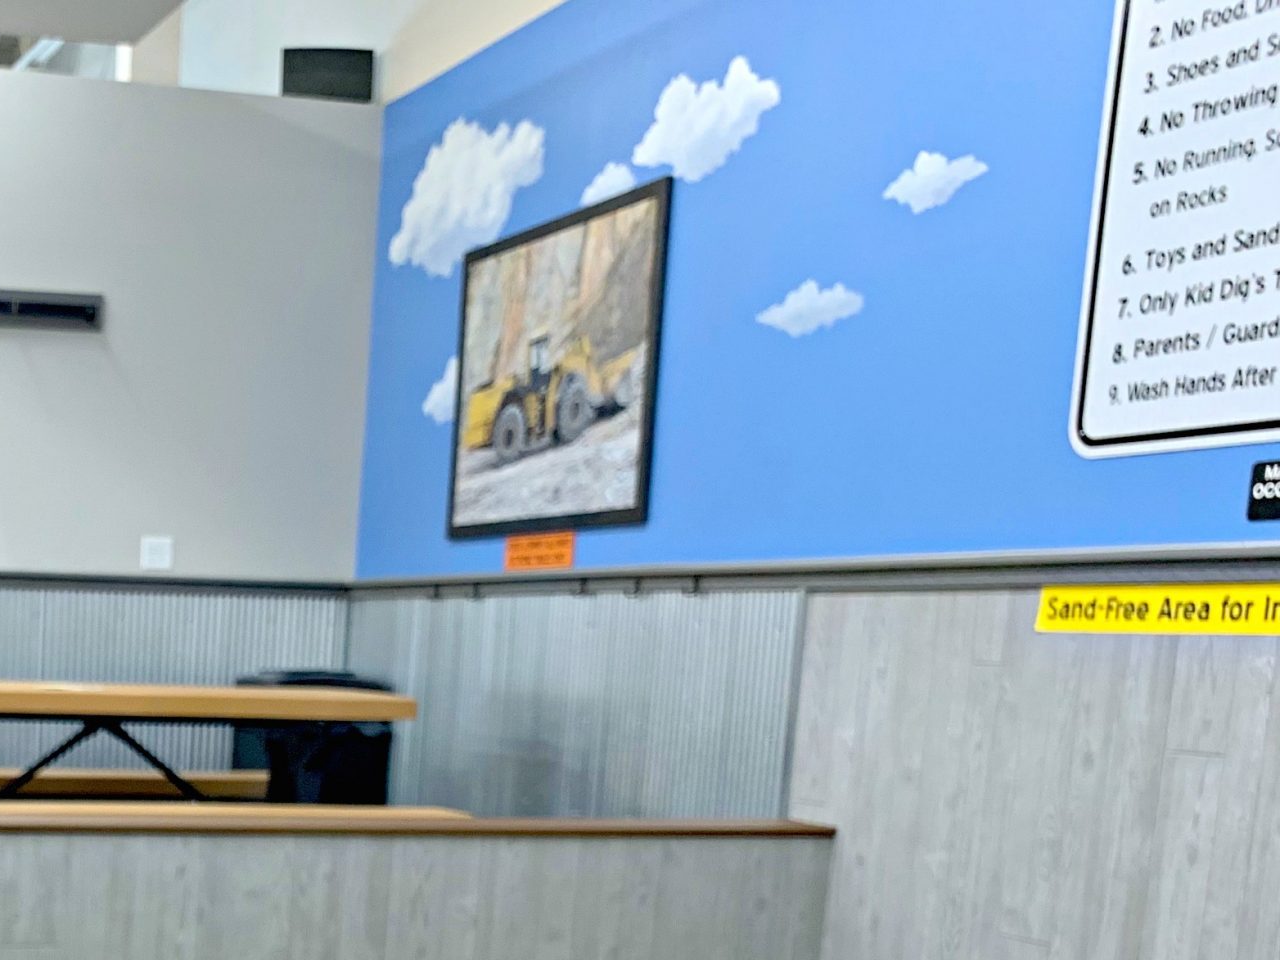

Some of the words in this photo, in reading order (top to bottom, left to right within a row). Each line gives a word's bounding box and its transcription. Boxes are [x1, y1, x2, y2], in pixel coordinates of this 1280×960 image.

[1148, 25, 1166, 49] 2.
[1171, 18, 1196, 42] No
[1143, 71, 1159, 94] 3.
[1166, 55, 1220, 88] Shoes
[1225, 37, 1260, 68] and
[1137, 116, 1154, 137] 4.
[1160, 109, 1185, 133] No
[1192, 83, 1279, 123] Throwing
[1131, 161, 1149, 185] 5.
[1153, 156, 1178, 179] No
[1149, 198, 1171, 219] on
[1176, 184, 1229, 213] Rocks
[1121, 254, 1137, 276] 6.
[1145, 245, 1186, 272] Toys
[1191, 233, 1228, 262] and
[1232, 221, 1280, 254] Sand
[1118, 297, 1132, 320] 7.
[1139, 290, 1179, 317] Only
[1183, 281, 1215, 308] Kid
[1219, 271, 1266, 304] Dig's
[1111, 341, 1128, 365] 8.
[1132, 330, 1202, 359] Parents
[1206, 322, 1218, 350] /
[1222, 315, 1280, 347] Guard
[1108, 383, 1122, 406] 9.
[1126, 376, 1170, 404] Wash
[1173, 371, 1227, 398] Hands
[1230, 363, 1277, 389] After
[1046, 596, 1150, 622] Sand-Free
[1157, 596, 1211, 622] Area
[1220, 594, 1255, 623] for
